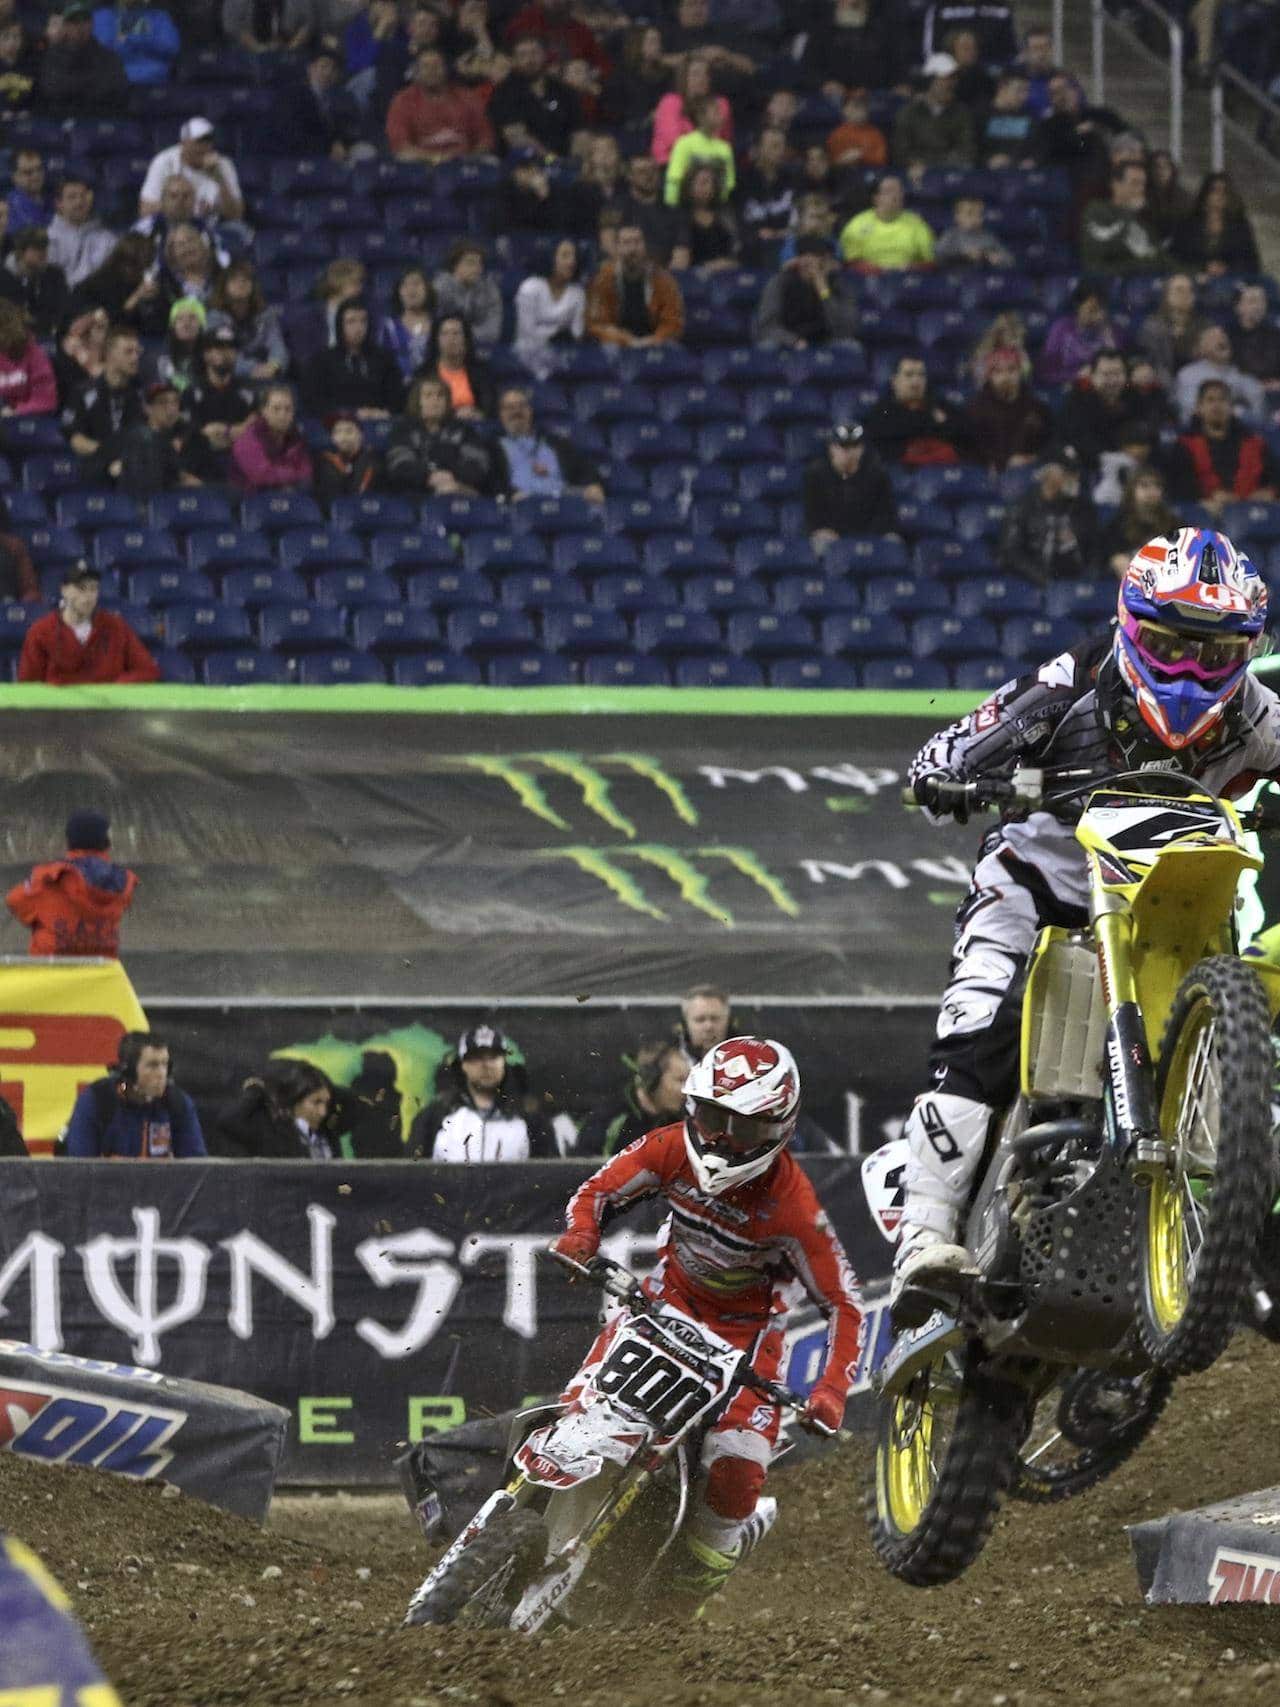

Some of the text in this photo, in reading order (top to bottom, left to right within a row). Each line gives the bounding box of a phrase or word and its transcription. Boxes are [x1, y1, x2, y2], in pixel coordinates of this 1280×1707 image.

[0, 1204, 660, 1367] ONST
[0, 1388, 175, 1477] OIL
[597, 1339, 712, 1437] 800
